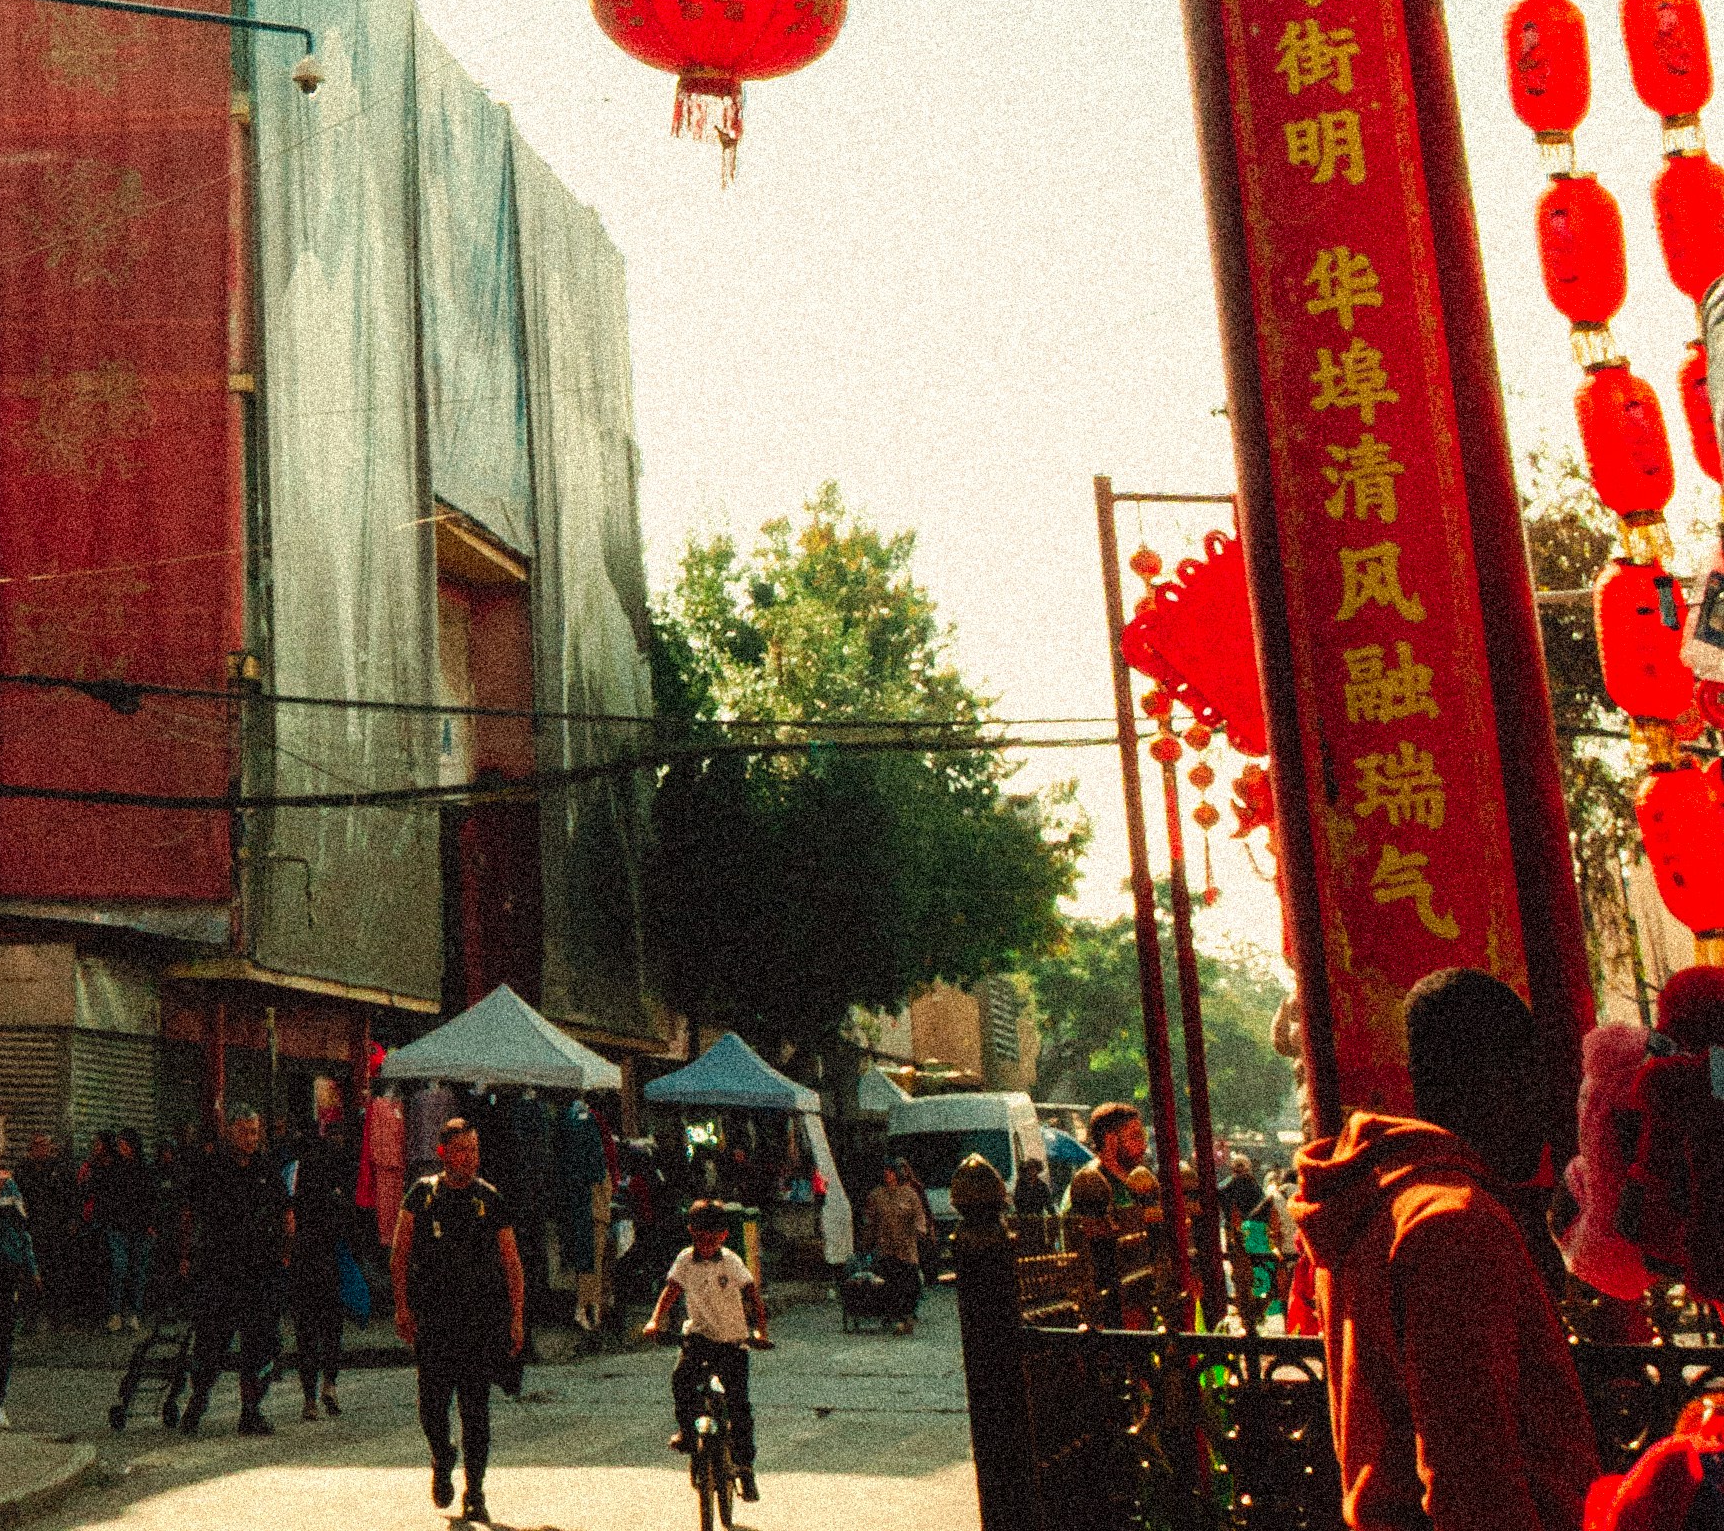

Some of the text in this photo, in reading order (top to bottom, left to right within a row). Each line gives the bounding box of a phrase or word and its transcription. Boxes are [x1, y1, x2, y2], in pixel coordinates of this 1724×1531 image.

[1305, 245, 1460, 940] 华埠清风融瑞气
